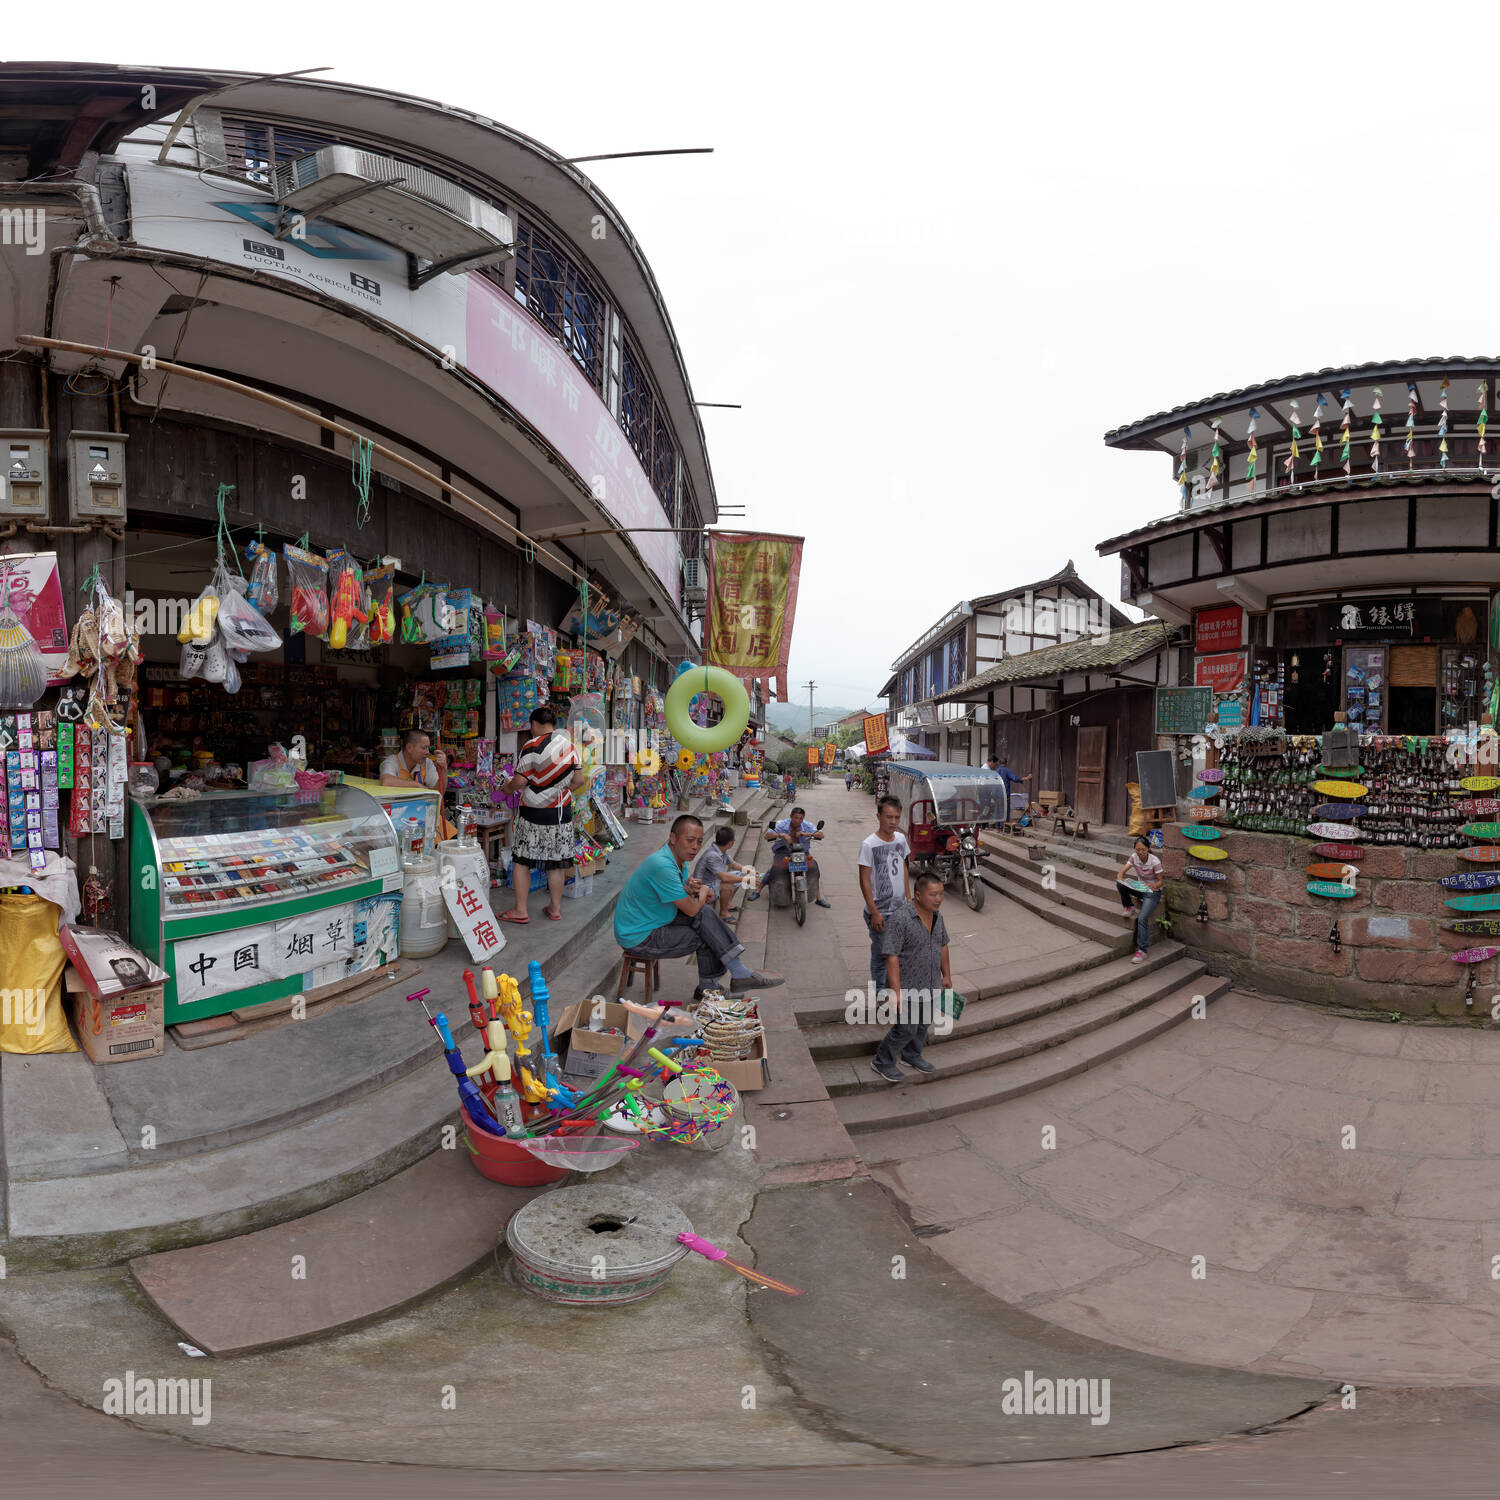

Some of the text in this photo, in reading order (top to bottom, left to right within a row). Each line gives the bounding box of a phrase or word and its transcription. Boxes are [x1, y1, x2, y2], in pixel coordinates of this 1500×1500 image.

[243, 253, 382, 305] GUOTIAN AGRICULTURE
[456, 886, 499, 951] 住宿
[188, 918, 346, 986] 中国烟草
